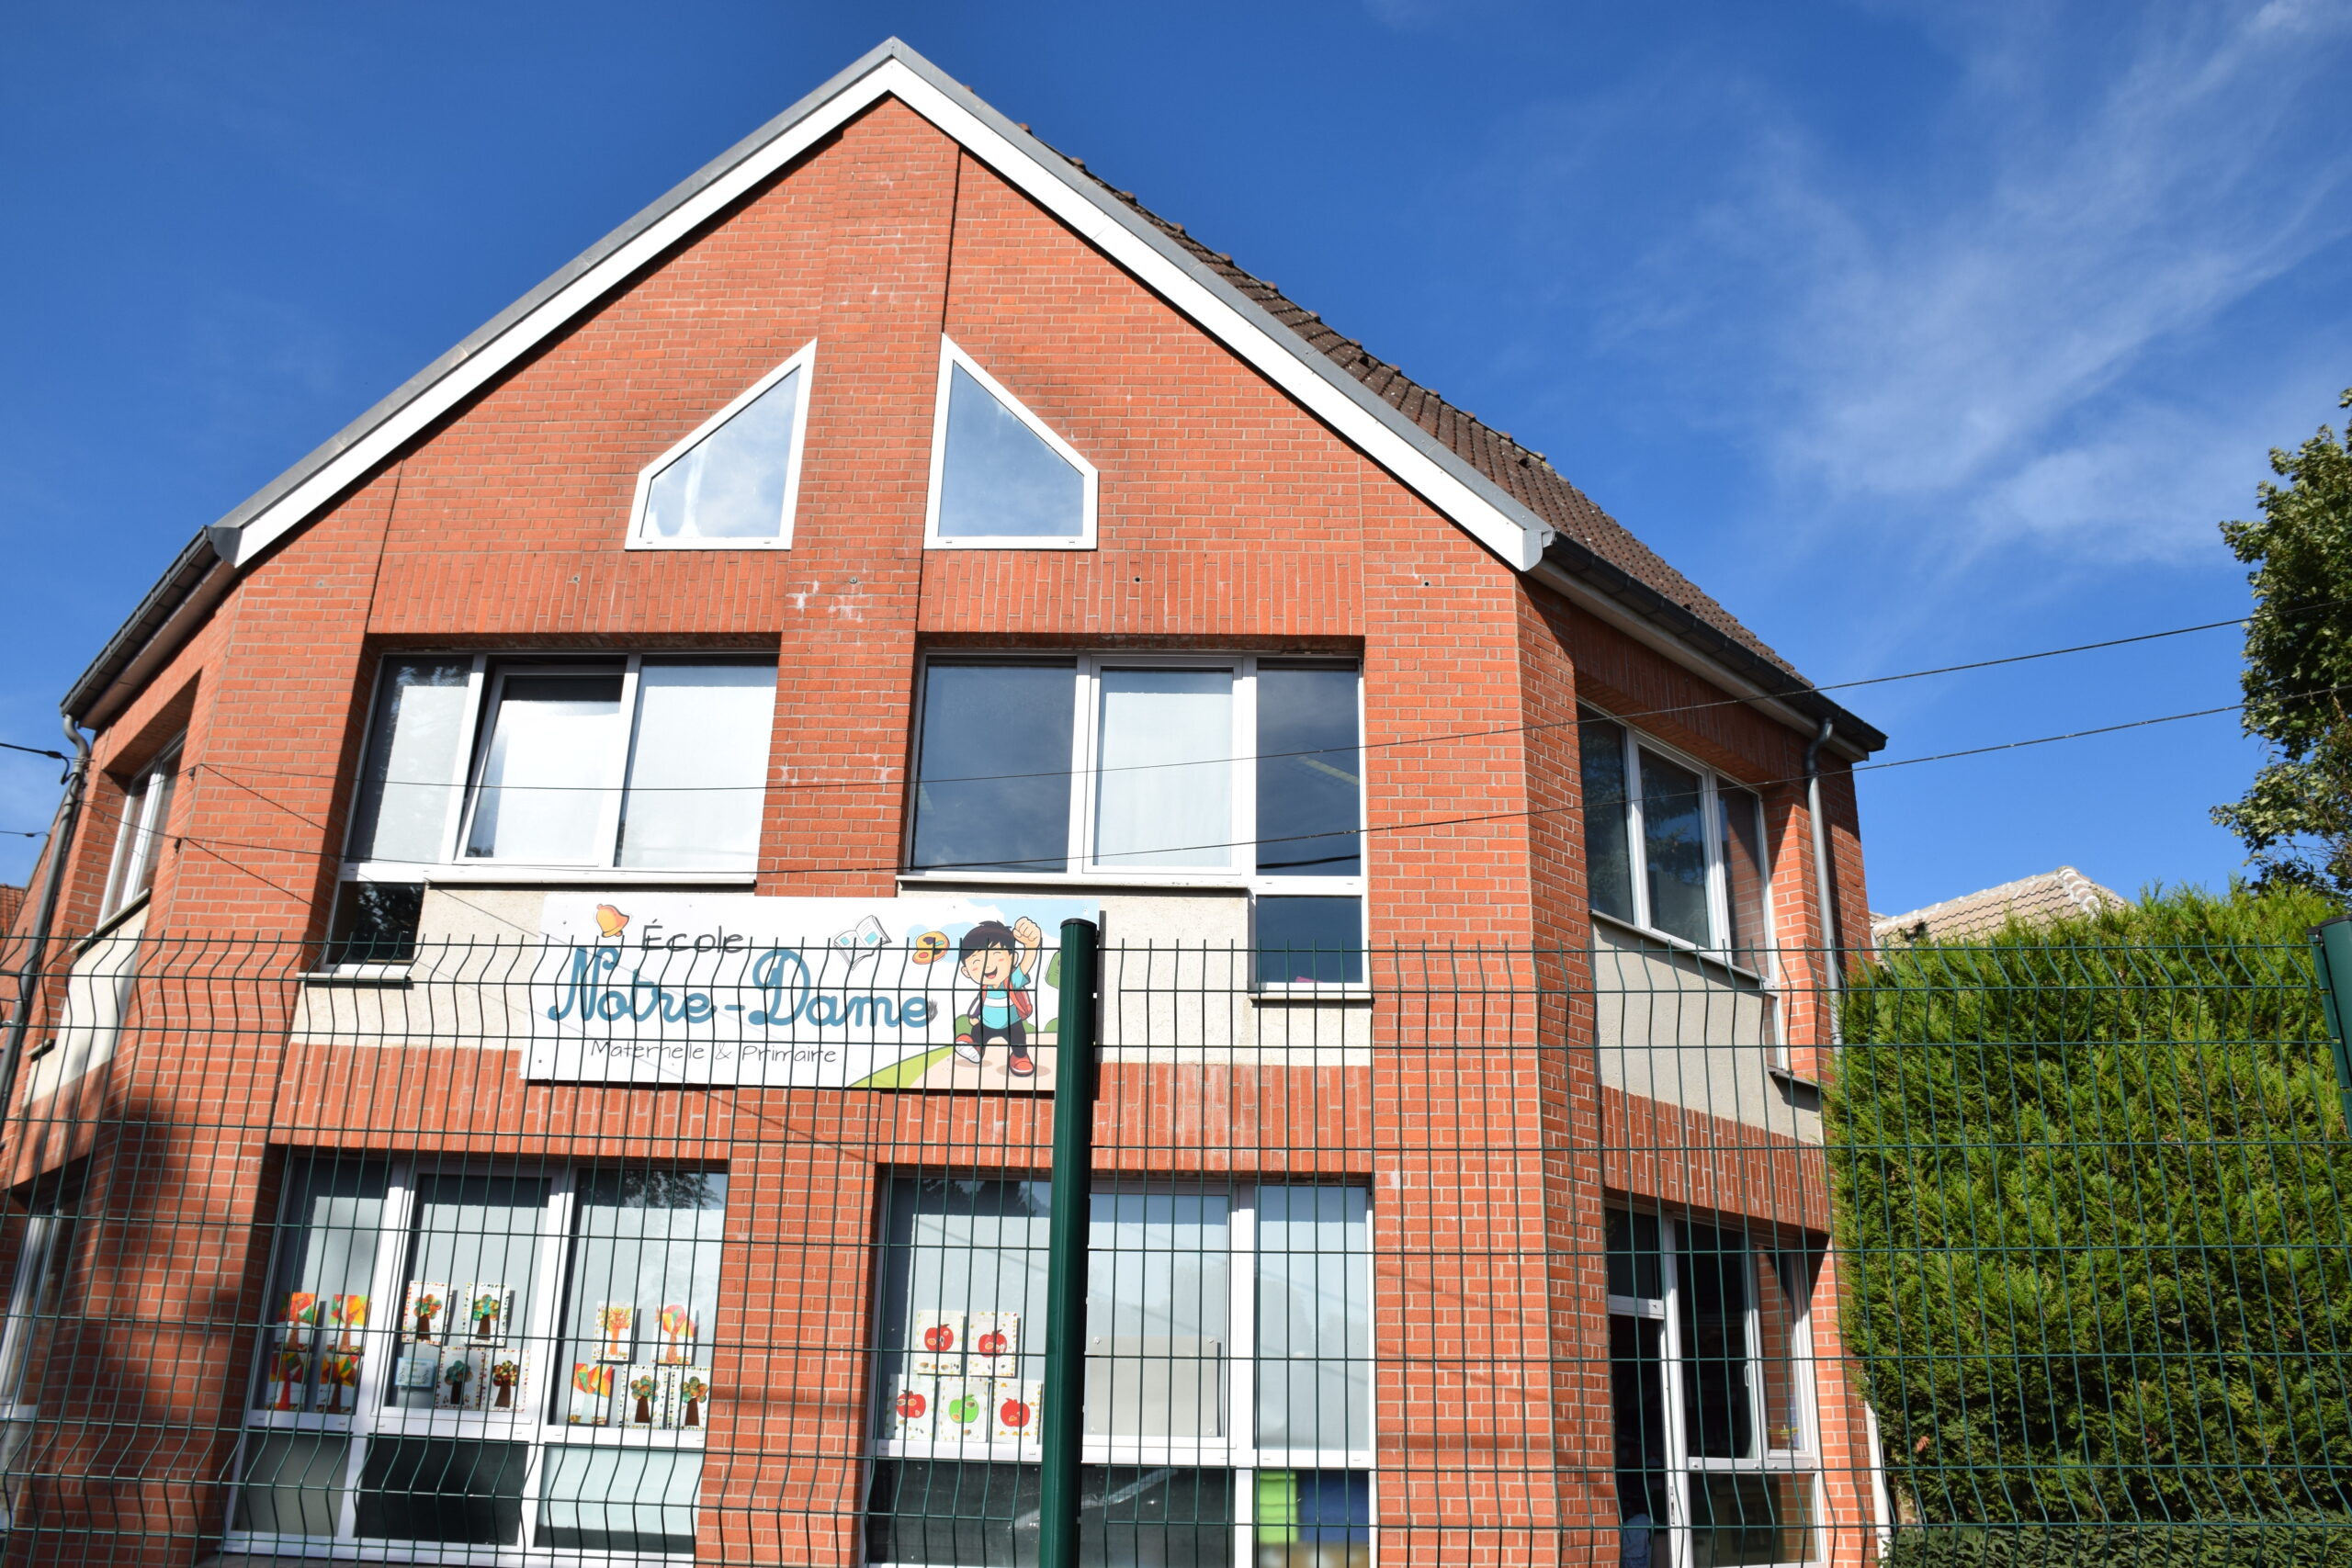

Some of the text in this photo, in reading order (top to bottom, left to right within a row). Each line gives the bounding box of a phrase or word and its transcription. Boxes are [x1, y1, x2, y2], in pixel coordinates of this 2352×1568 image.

[641, 919, 743, 953] École
[548, 946, 929, 1028] Notre-Dame
[591, 1040, 837, 1063] Maternele & Primaire
